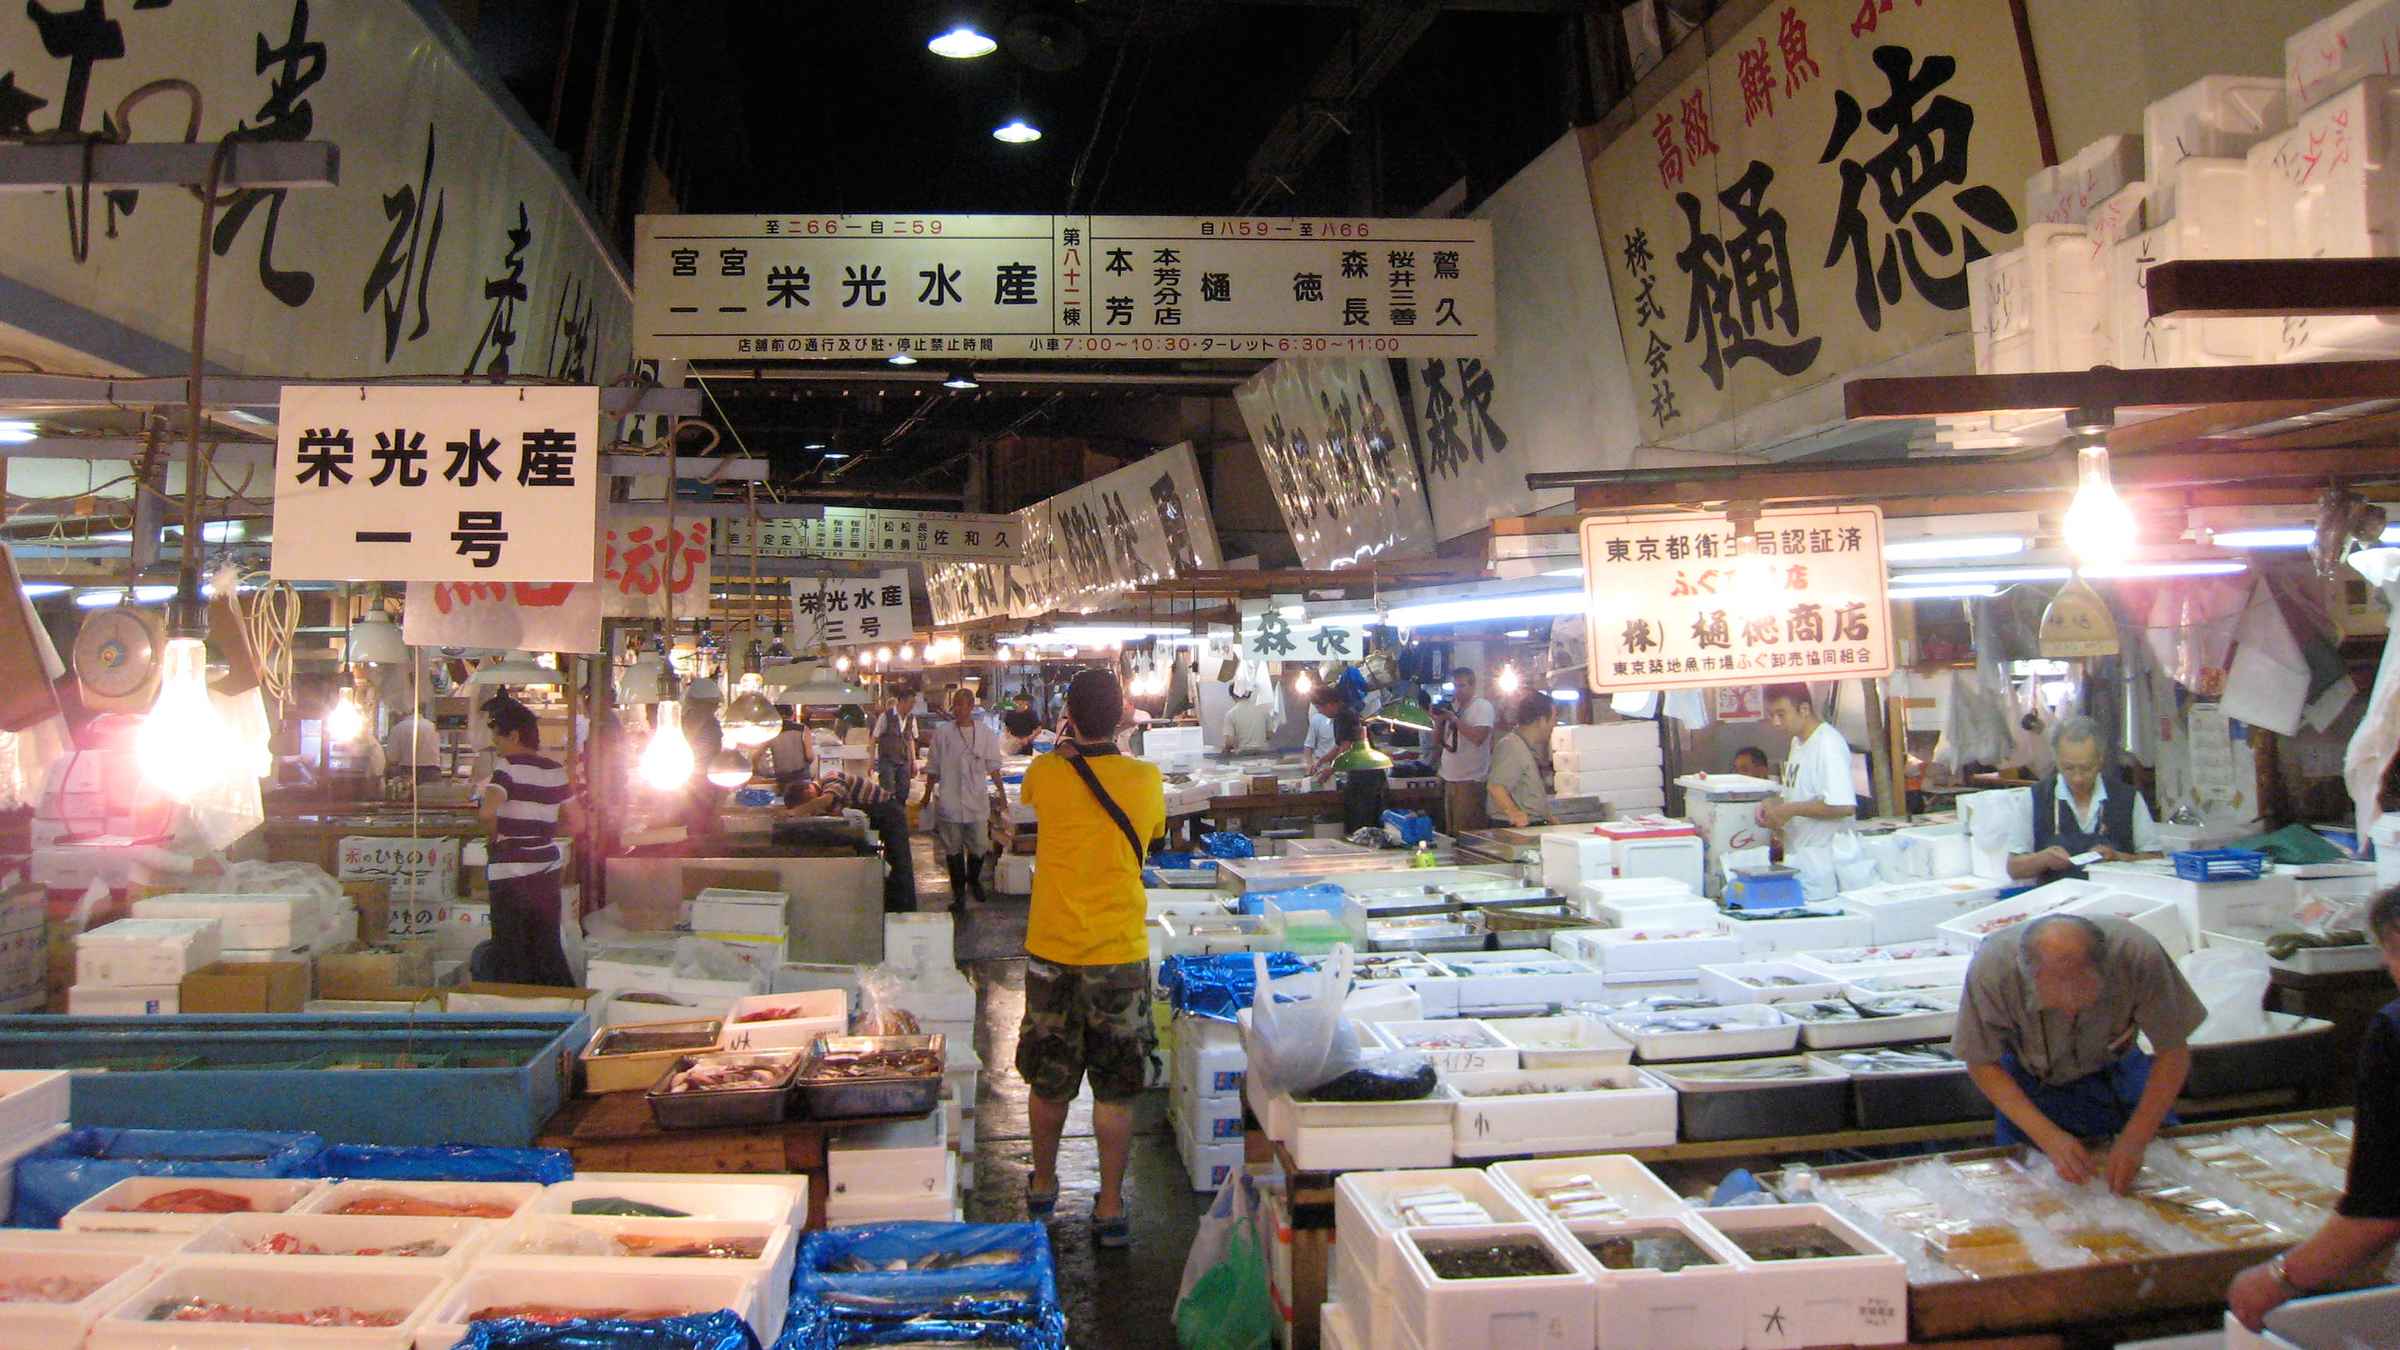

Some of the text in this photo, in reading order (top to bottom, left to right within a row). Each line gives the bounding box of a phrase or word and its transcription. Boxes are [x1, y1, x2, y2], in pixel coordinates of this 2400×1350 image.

[766, 262, 1039, 309] 栄光水産
[1063, 227, 1081, 327] 第八十二棟
[1105, 246, 1134, 327] 本芳
[1152, 247, 1182, 326] 本芳分店
[1341, 249, 1370, 327] 森長
[1623, 227, 1681, 429] 株式会社
[296, 428, 577, 488] 栄光水産
[355, 510, 509, 568] 一号
[934, 529, 1010, 549] 佐和久
[799, 584, 904, 615] 栄光水産
[825, 616, 882, 642] 三号
